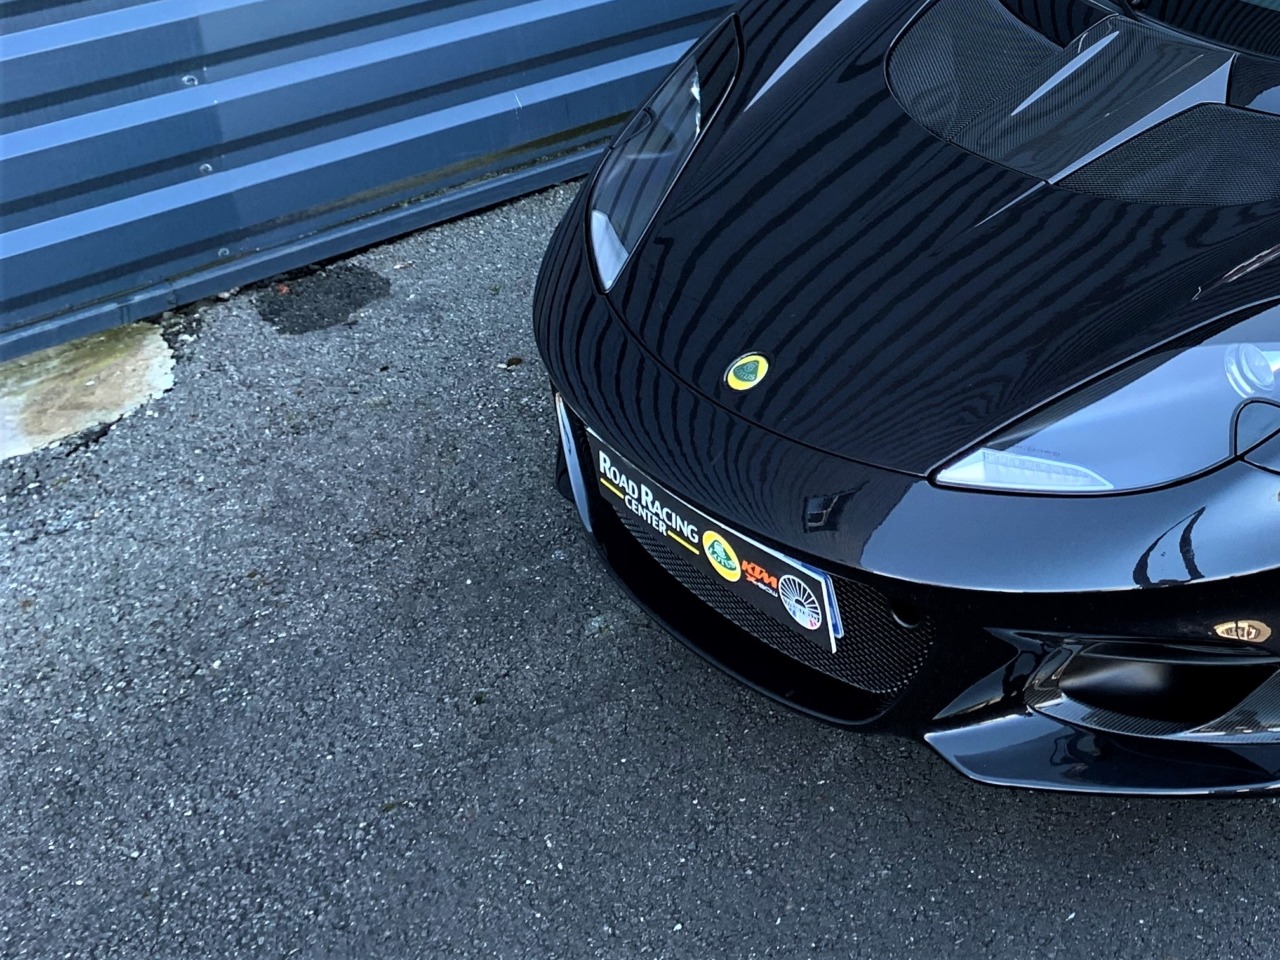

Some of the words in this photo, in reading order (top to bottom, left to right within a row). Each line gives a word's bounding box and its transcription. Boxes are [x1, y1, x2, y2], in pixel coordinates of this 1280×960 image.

[599, 450, 639, 499] ROAD
[640, 483, 699, 544] RACING
[624, 495, 667, 537] CENTER
[707, 546, 737, 571] LOTUS
[741, 560, 778, 589] KTM
